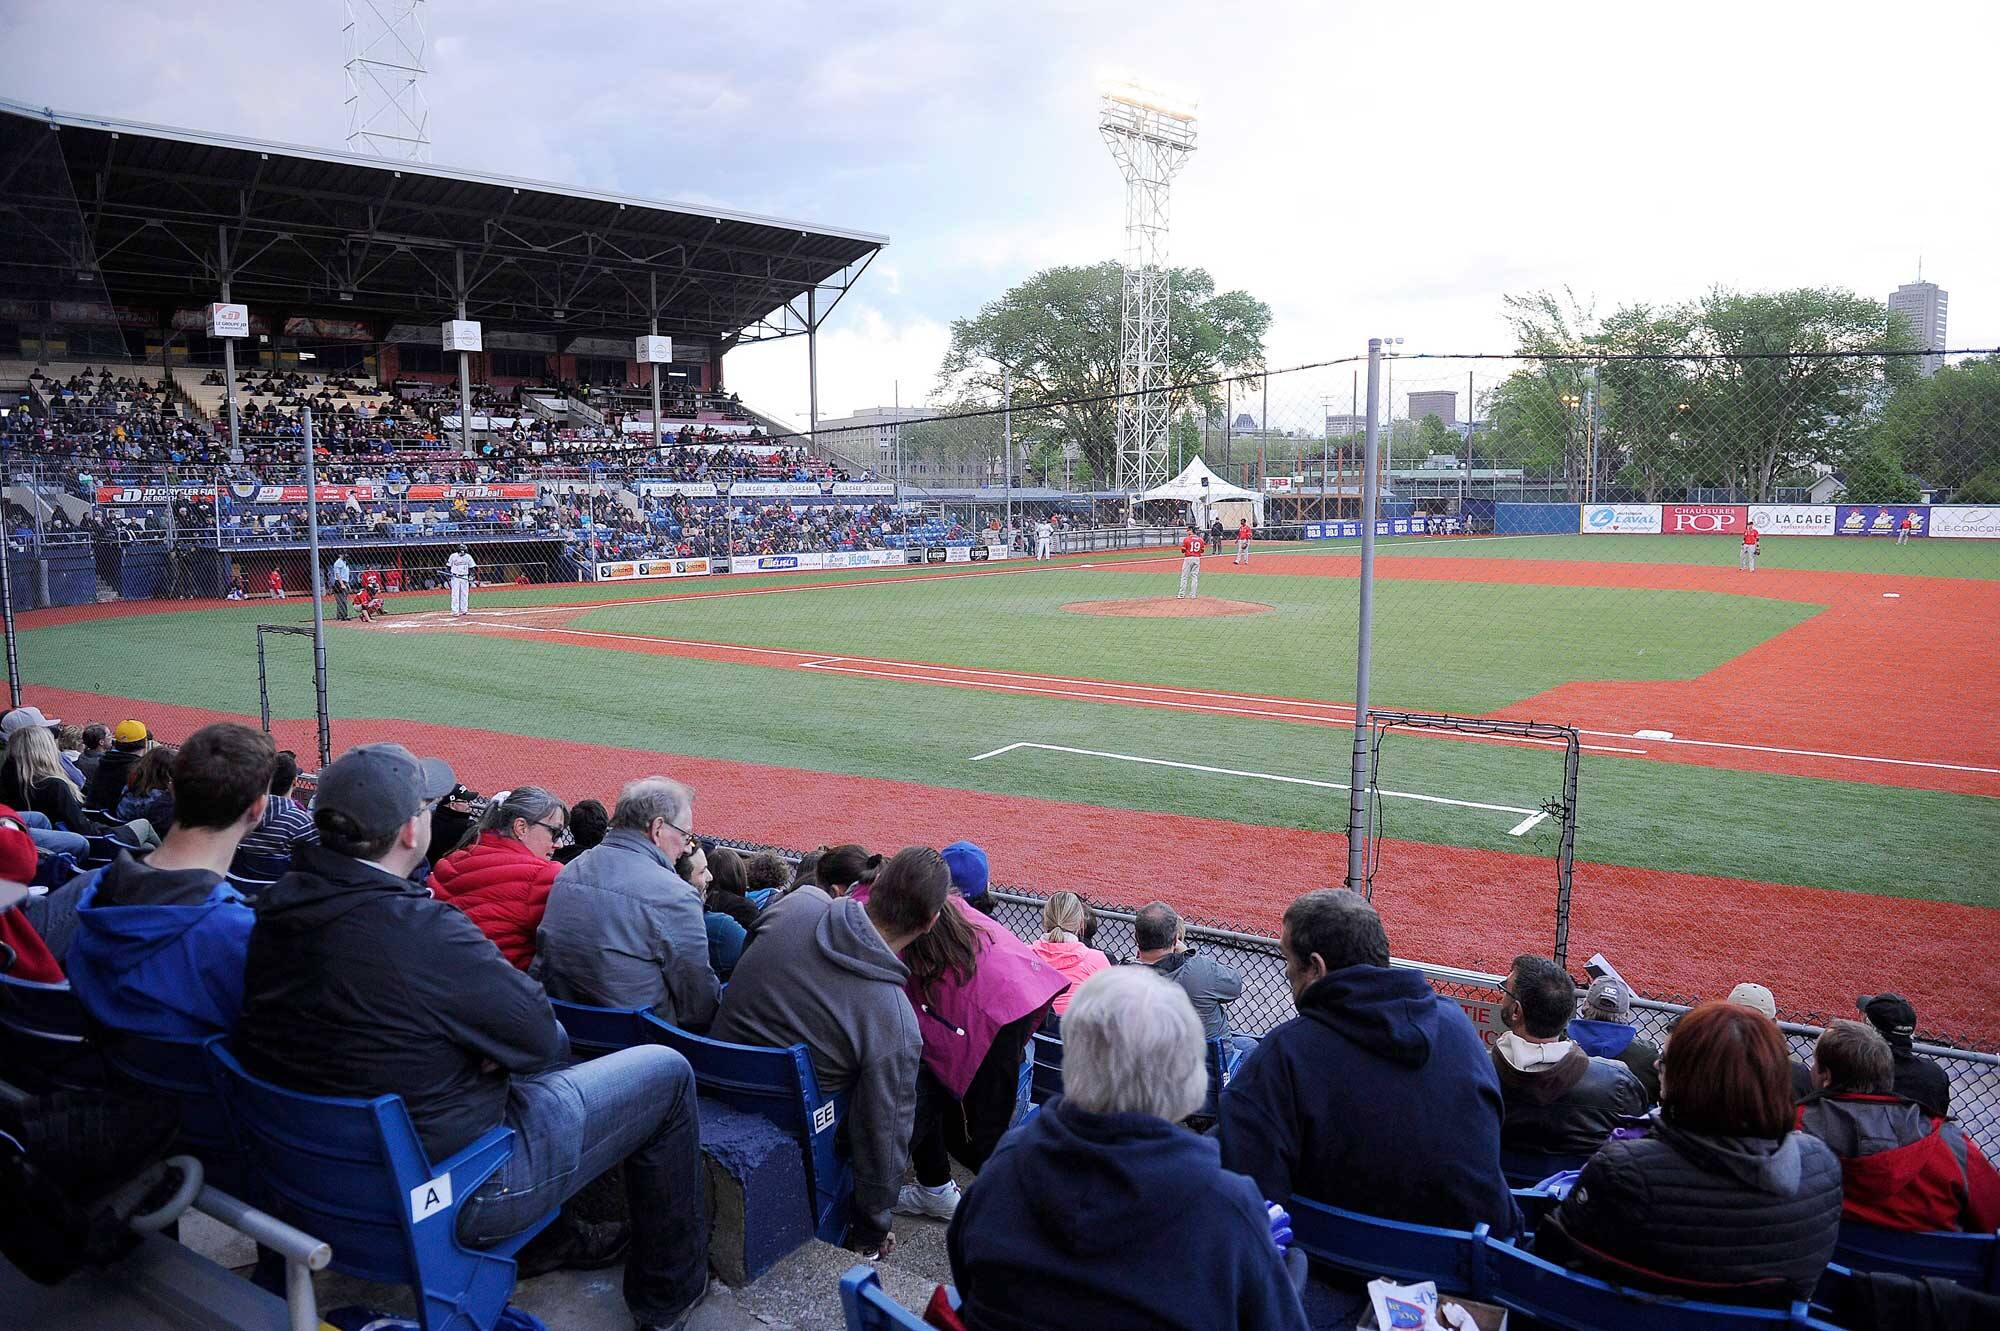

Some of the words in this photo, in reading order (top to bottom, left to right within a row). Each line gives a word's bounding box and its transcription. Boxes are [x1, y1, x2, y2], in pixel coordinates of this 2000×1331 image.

[144, 488, 157, 496] JD
[1674, 507, 1735, 515] CHAUSSURES
[1615, 515, 1655, 523] LAVAL
[1673, 514, 1736, 531] POP
[1775, 514, 1791, 524] LA
[1796, 514, 1832, 524] CAGE
[1190, 541, 1201, 552] 19
[815, 1104, 833, 1129] EE
[424, 1186, 440, 1210] A
